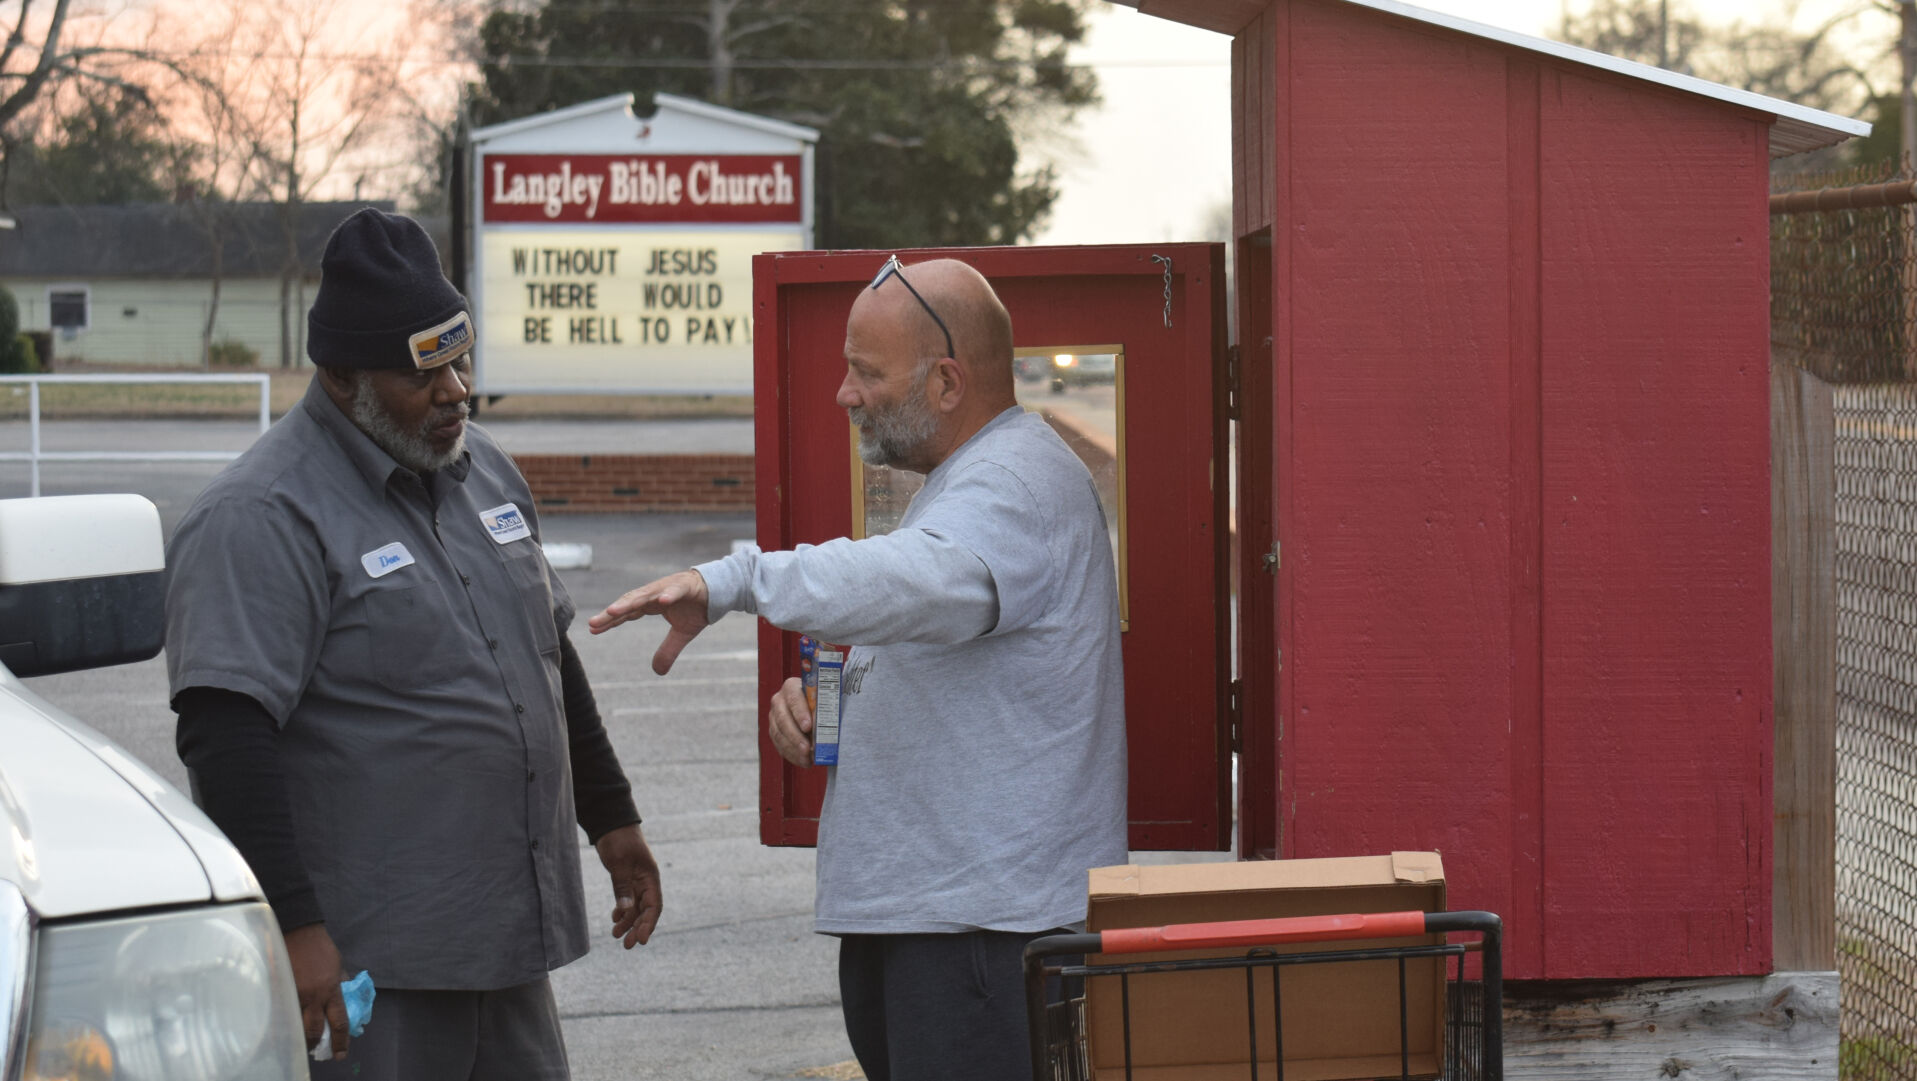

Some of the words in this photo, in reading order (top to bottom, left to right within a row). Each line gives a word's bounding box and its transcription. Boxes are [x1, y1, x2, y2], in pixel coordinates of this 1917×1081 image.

[492, 161, 604, 218] Langley
[609, 160, 682, 205] Bible
[687, 161, 795, 205] Church
[513, 249, 619, 276] WITHOUT
[645, 248, 717, 276] JESUS
[525, 283, 598, 310] THERE
[642, 283, 723, 310] WOULD
[440, 328, 466, 346] Shaw
[524, 317, 553, 345] BE
[569, 317, 624, 345] HELL
[640, 317, 670, 345] TO
[497, 515, 522, 529] Shaw
